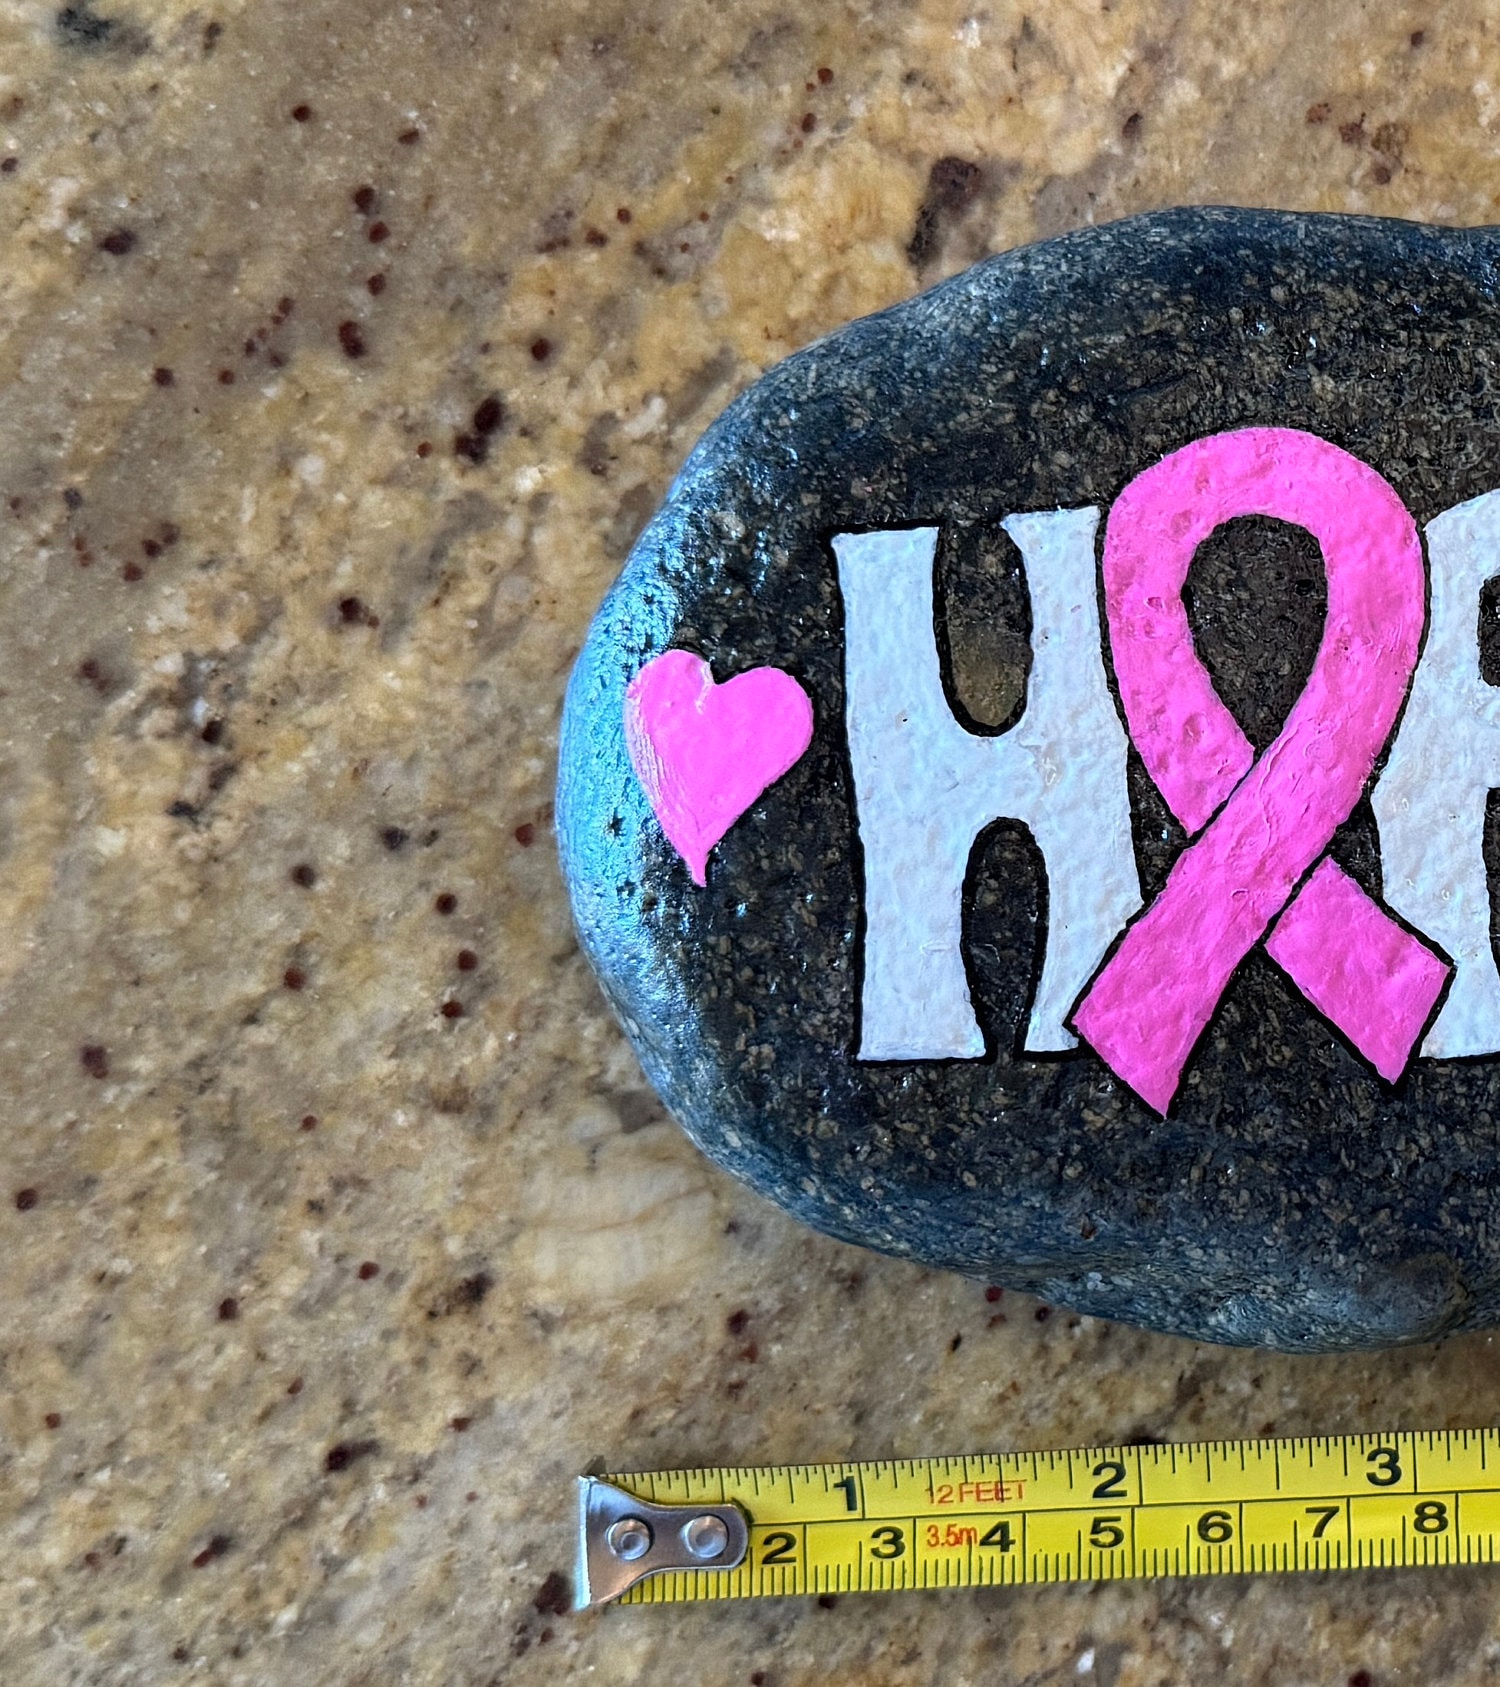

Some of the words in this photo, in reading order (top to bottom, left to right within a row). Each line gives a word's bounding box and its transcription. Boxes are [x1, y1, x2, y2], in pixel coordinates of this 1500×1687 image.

[833, 1475, 858, 1512] 1
[1091, 1461, 1128, 1499] 2
[1365, 1447, 1402, 1487] 3
[925, 1484, 954, 1505] 12
[959, 1479, 1028, 1503] FEET
[761, 1531, 798, 1566] 2
[870, 1526, 906, 1559] 3
[979, 1521, 1016, 1553] 4
[1089, 1515, 1125, 1549] 5
[1199, 1510, 1234, 1544] 6
[1304, 1505, 1341, 1539] 7
[1413, 1500, 1450, 1535] 8
[926, 1523, 977, 1548] 3.5m
